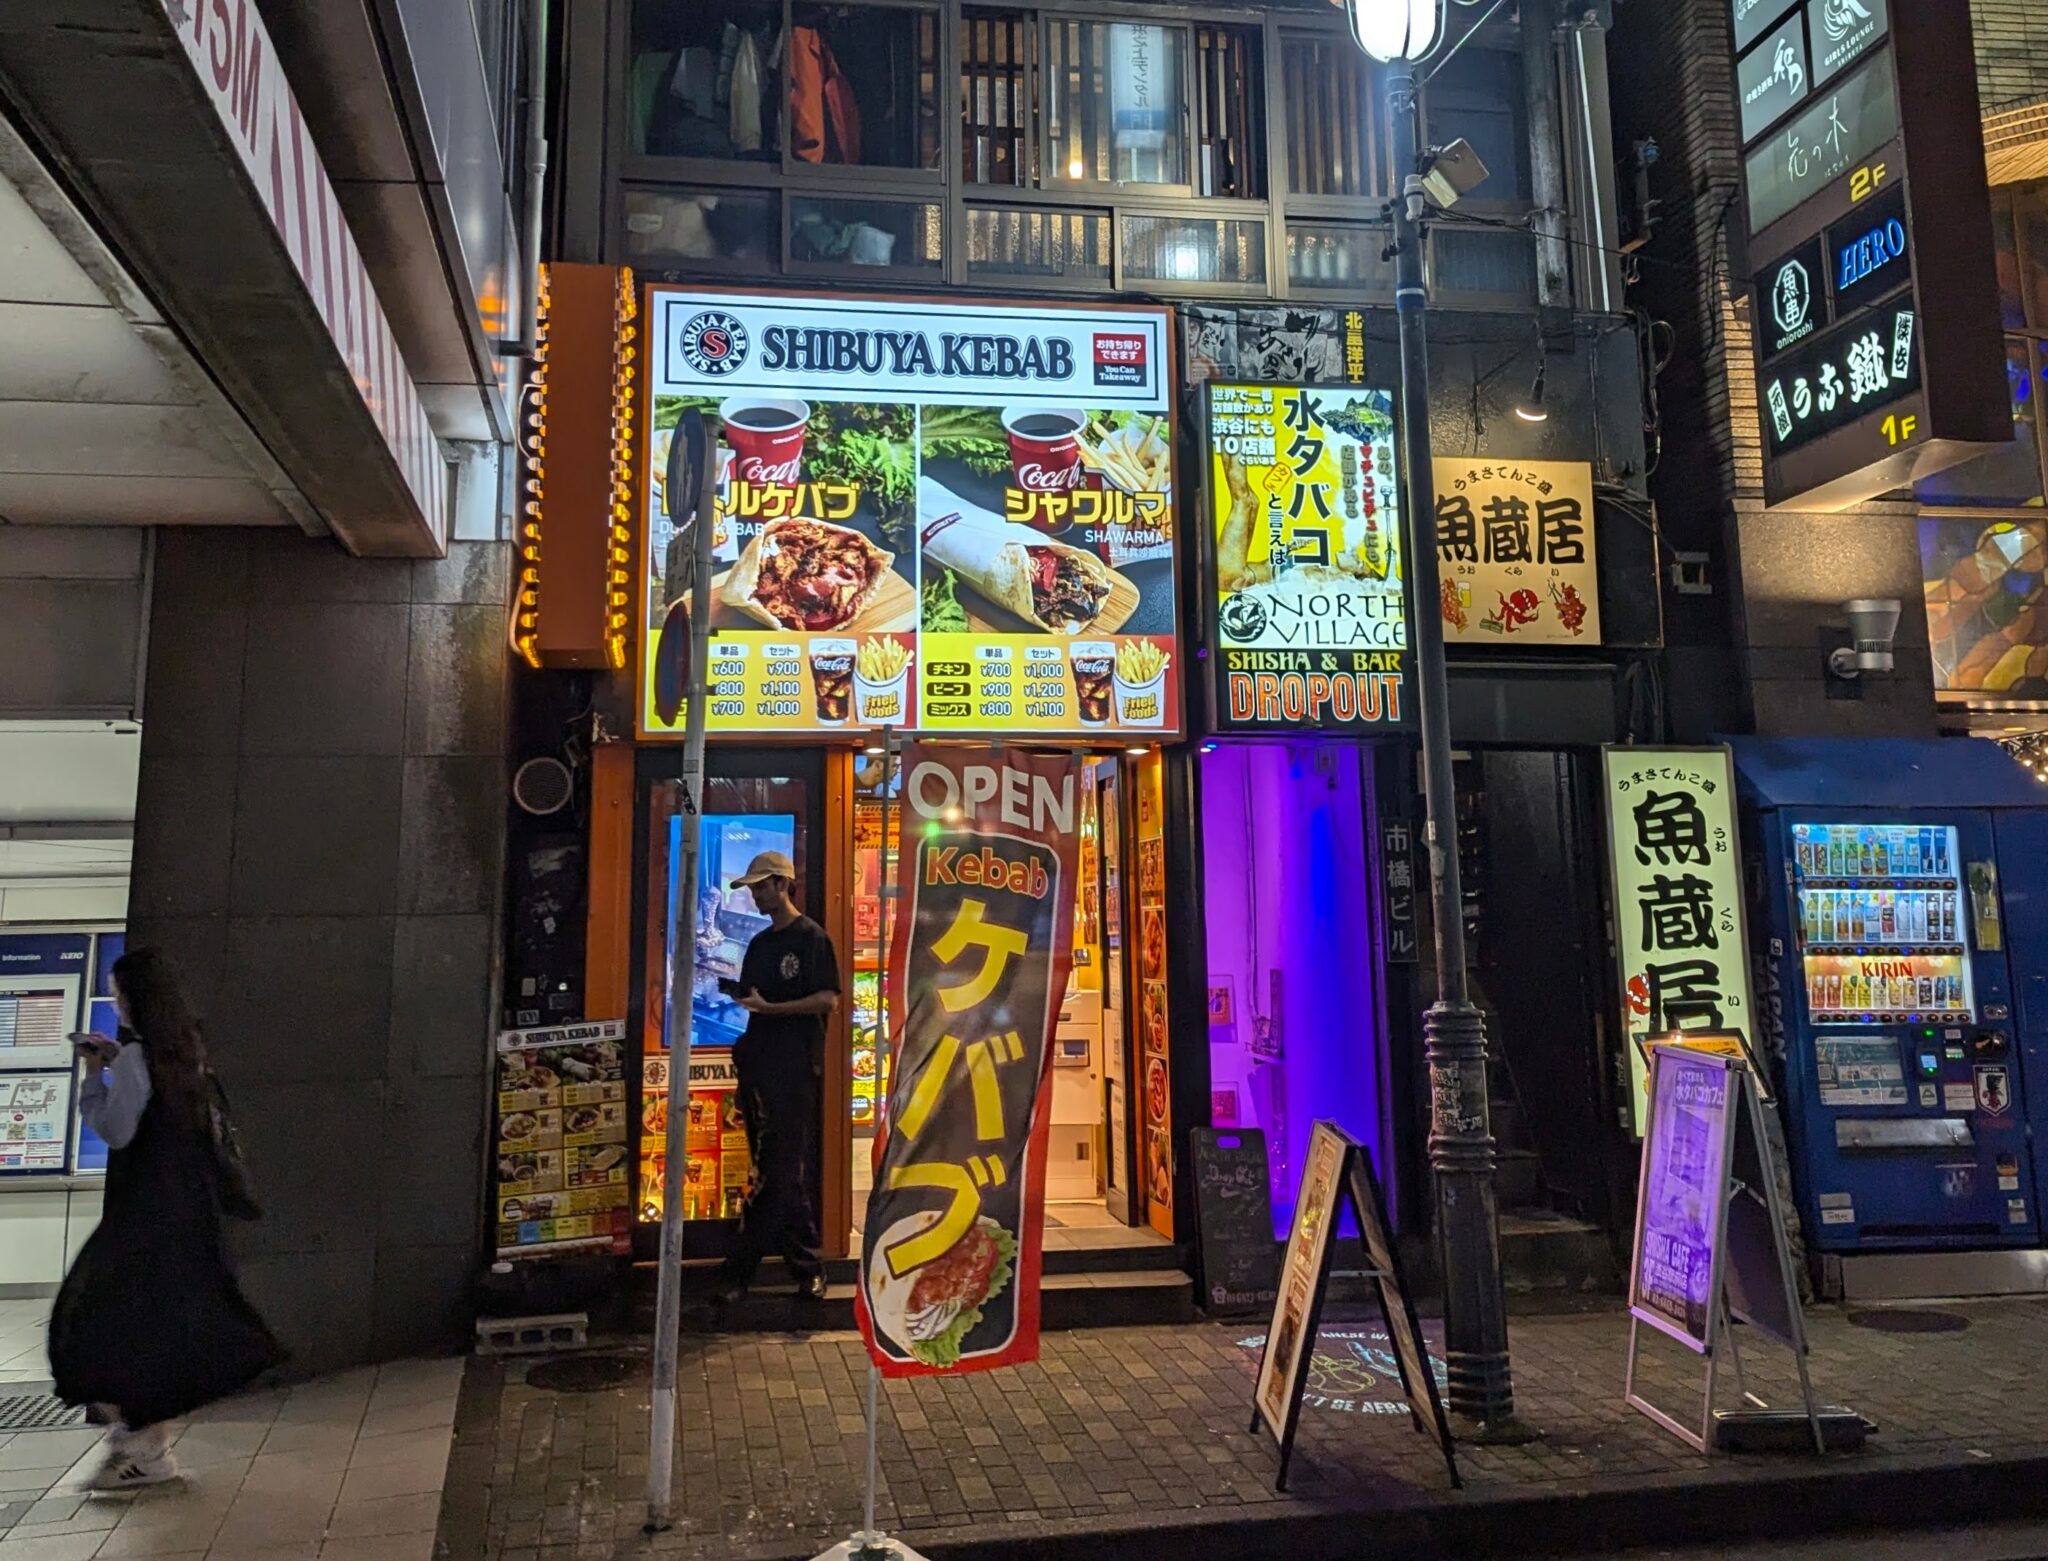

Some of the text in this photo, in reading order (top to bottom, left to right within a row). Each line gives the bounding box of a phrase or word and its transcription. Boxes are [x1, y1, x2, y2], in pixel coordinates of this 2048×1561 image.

[1850, 163, 1886, 202] 2F
[1839, 218, 1905, 290] HERO
[1782, 268, 1800, 326] 魚串
[702, 330, 727, 358] S
[1095, 338, 1142, 350] お持ち帰り
[1776, 319, 1813, 350] onioroshi
[761, 325, 1076, 381] SHIBUYA KEBAB
[1100, 350, 1138, 361] できます
[1098, 372, 1141, 384] Takeaway
[1104, 365, 1136, 375] You Can
[1211, 418, 1276, 435] 渋谷にも
[1881, 414, 1916, 445] 1F
[1283, 390, 1332, 567] 水タバコ
[661, 478, 860, 520] ルケバブ
[1005, 486, 1167, 526] シャワルマ
[1084, 529, 1165, 544] SHAWARMA
[1435, 493, 1585, 565] 魚蔵居
[1267, 593, 1405, 618] NORTH
[1269, 620, 1406, 648] VILLAGE
[719, 645, 794, 657] 単品 セット
[984, 648, 1056, 659] 単品 セット
[1228, 651, 1402, 671] SHISHA & BAR
[712, 661, 800, 676] ¥600 ¥900
[932, 664, 965, 675] チキン
[980, 663, 1012, 677] ¥700
[933, 683, 964, 696] ビーフ
[980, 683, 1012, 697] ¥900
[1124, 692, 1155, 708] Fried
[1228, 671, 1404, 722] DROPOUT
[712, 701, 745, 716] ¥700
[930, 703, 968, 716] ミックス
[980, 702, 1012, 716] ¥800
[1618, 767, 1717, 795] うまさてんこ盛
[908, 761, 1074, 834] OPEN
[1713, 827, 1727, 853] うお
[926, 846, 1049, 900] Kebab
[1384, 824, 1414, 953] 市橋ビル
[1632, 789, 1724, 1031] 魚蔵居
[1720, 907, 1734, 933] くら
[60, 952, 84, 960] KEIO
[1861, 962, 1913, 978] KIRIN
[1727, 994, 1740, 1007] い
[567, 1026, 601, 1041] KEBAB
[689, 1064, 730, 1081] IBUYA
[884, 898, 1029, 1280] ケバブ
